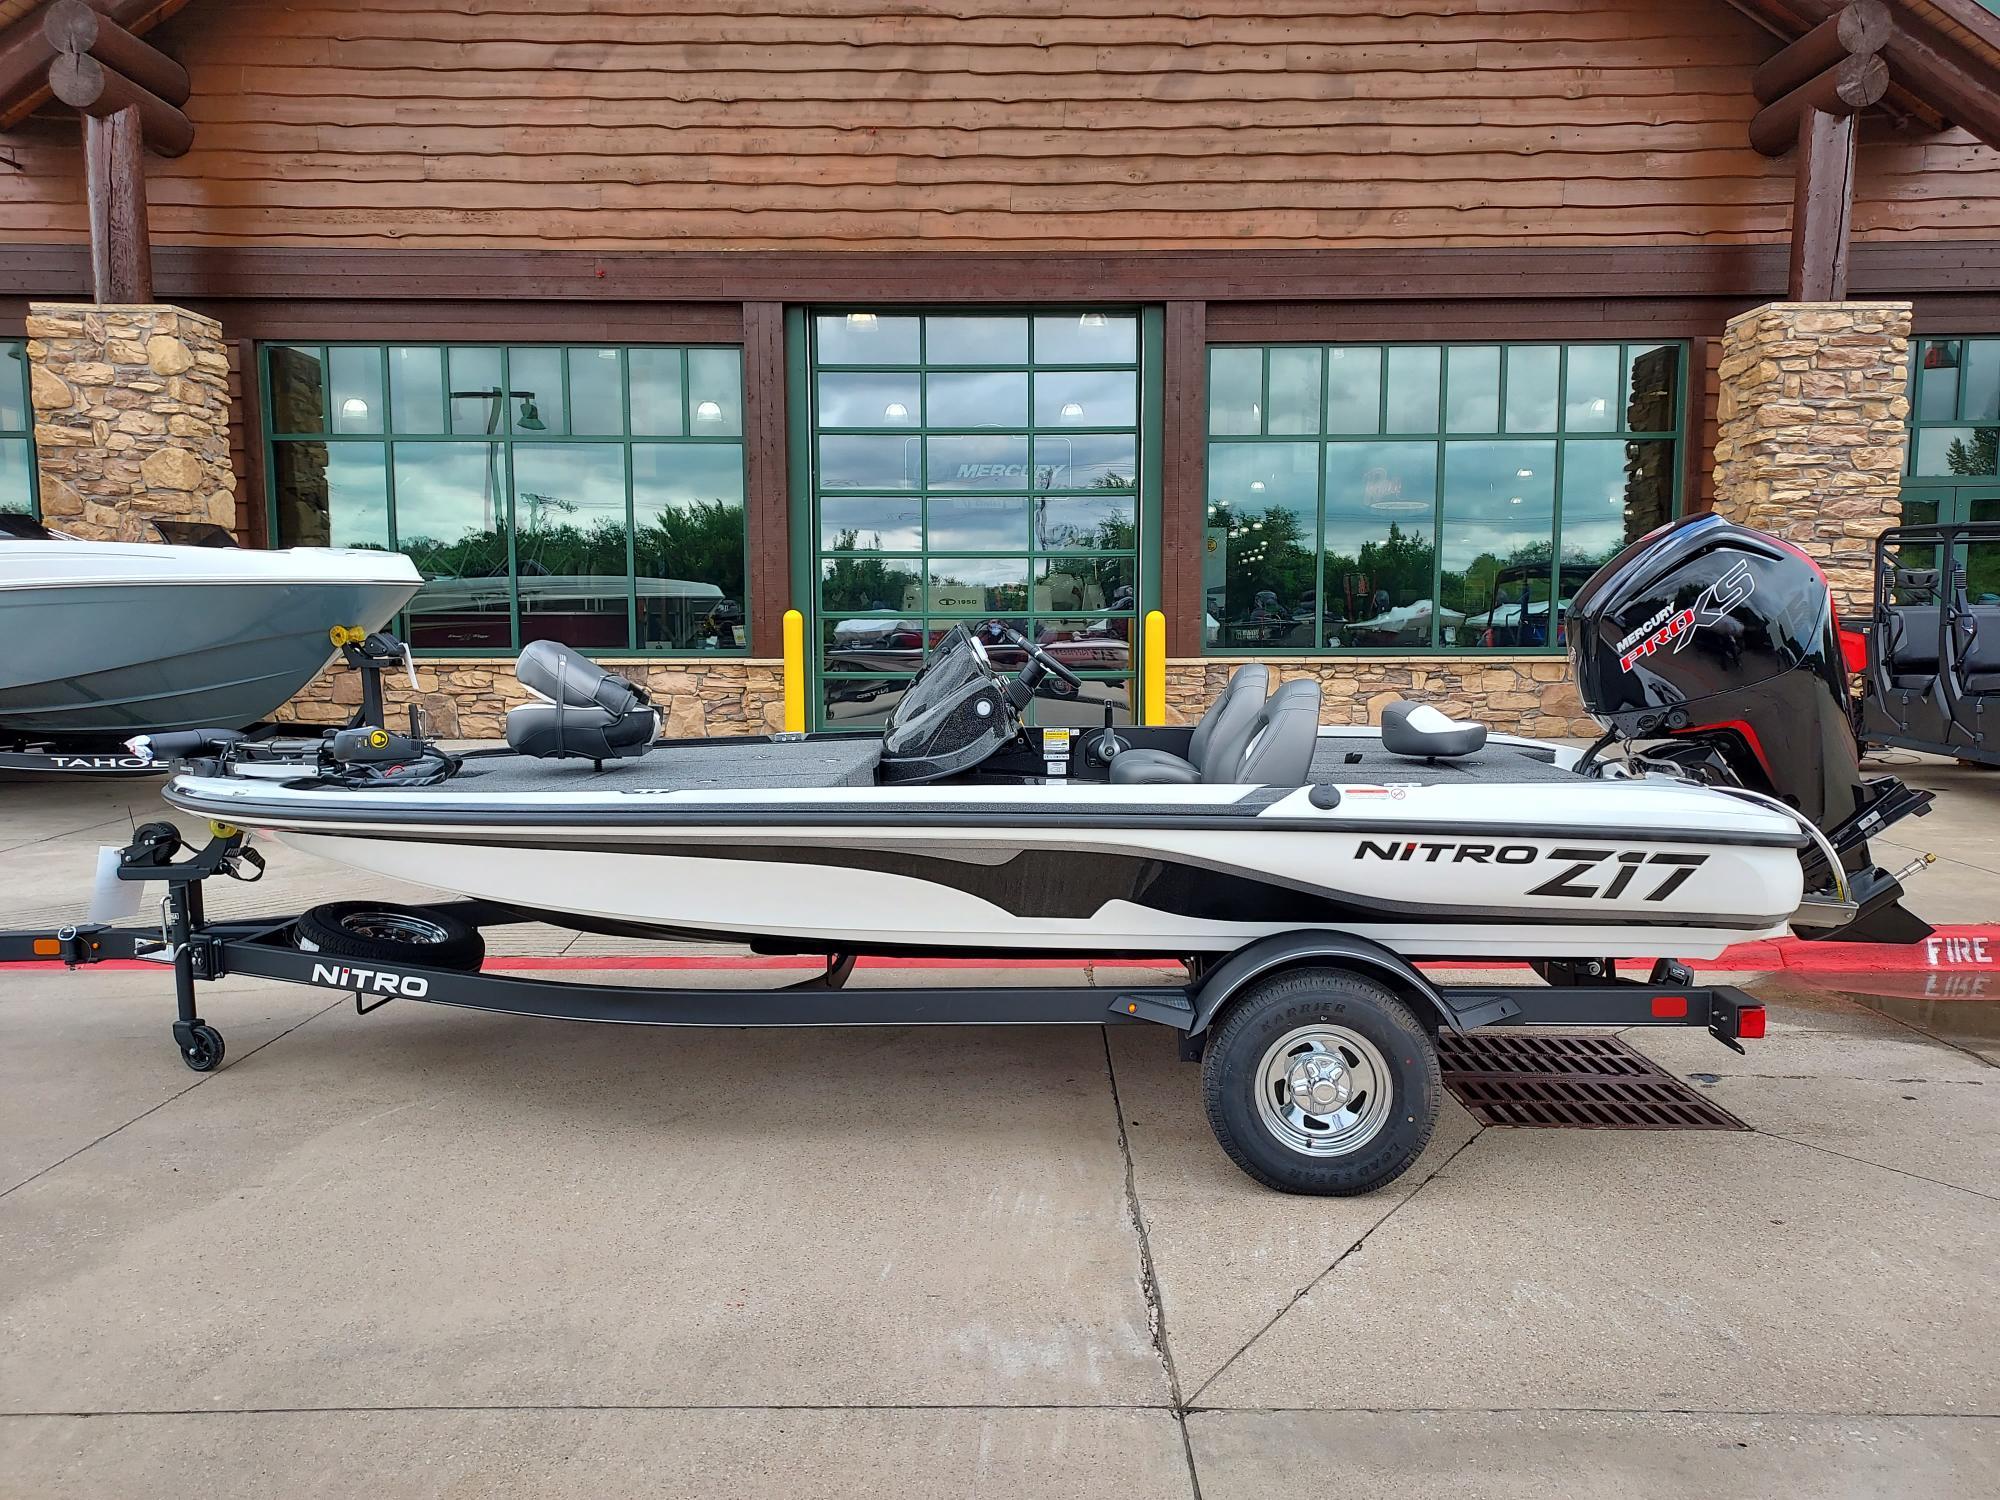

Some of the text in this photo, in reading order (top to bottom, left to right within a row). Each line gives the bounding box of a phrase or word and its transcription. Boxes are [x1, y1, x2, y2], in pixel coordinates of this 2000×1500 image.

[1616, 602, 1676, 653] MERCURY
[1353, 840, 1712, 902] NITRO Z17
[1926, 937, 1993, 966] FIRE
[311, 963, 429, 998] NITRO
